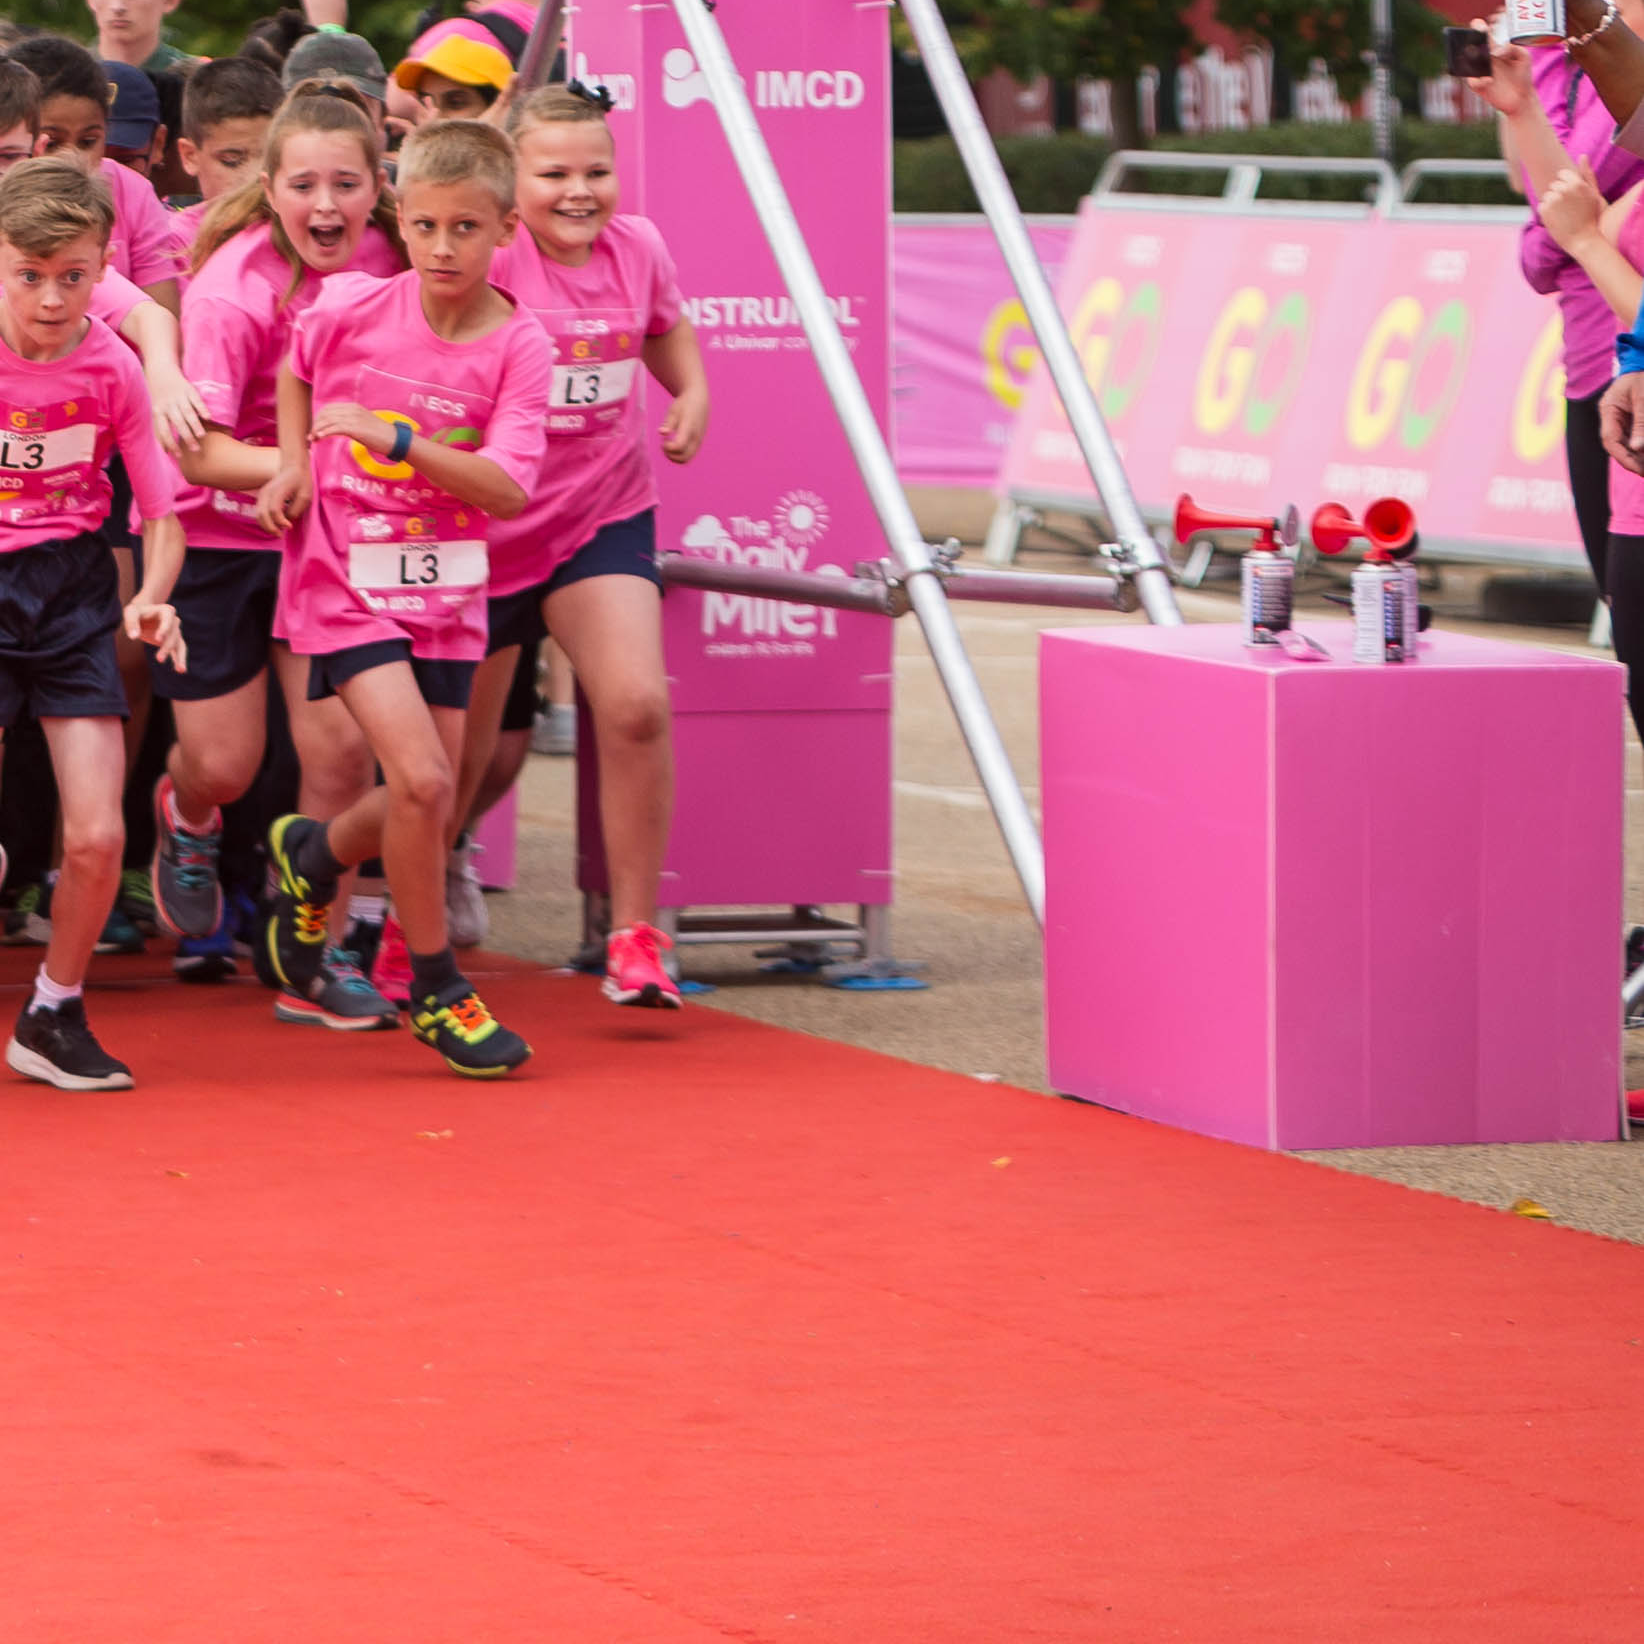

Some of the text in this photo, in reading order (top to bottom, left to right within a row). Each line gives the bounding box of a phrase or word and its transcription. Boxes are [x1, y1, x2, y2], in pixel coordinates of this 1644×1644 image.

[755, 70, 864, 109] IMCD
[564, 374, 601, 405] L3
[408, 394, 467, 419] INEOS
[3, 432, 48, 443] LONDON
[0, 441, 45, 471] L3
[341, 473, 388, 496] RUN
[729, 515, 772, 539] The
[399, 553, 440, 585] L3
